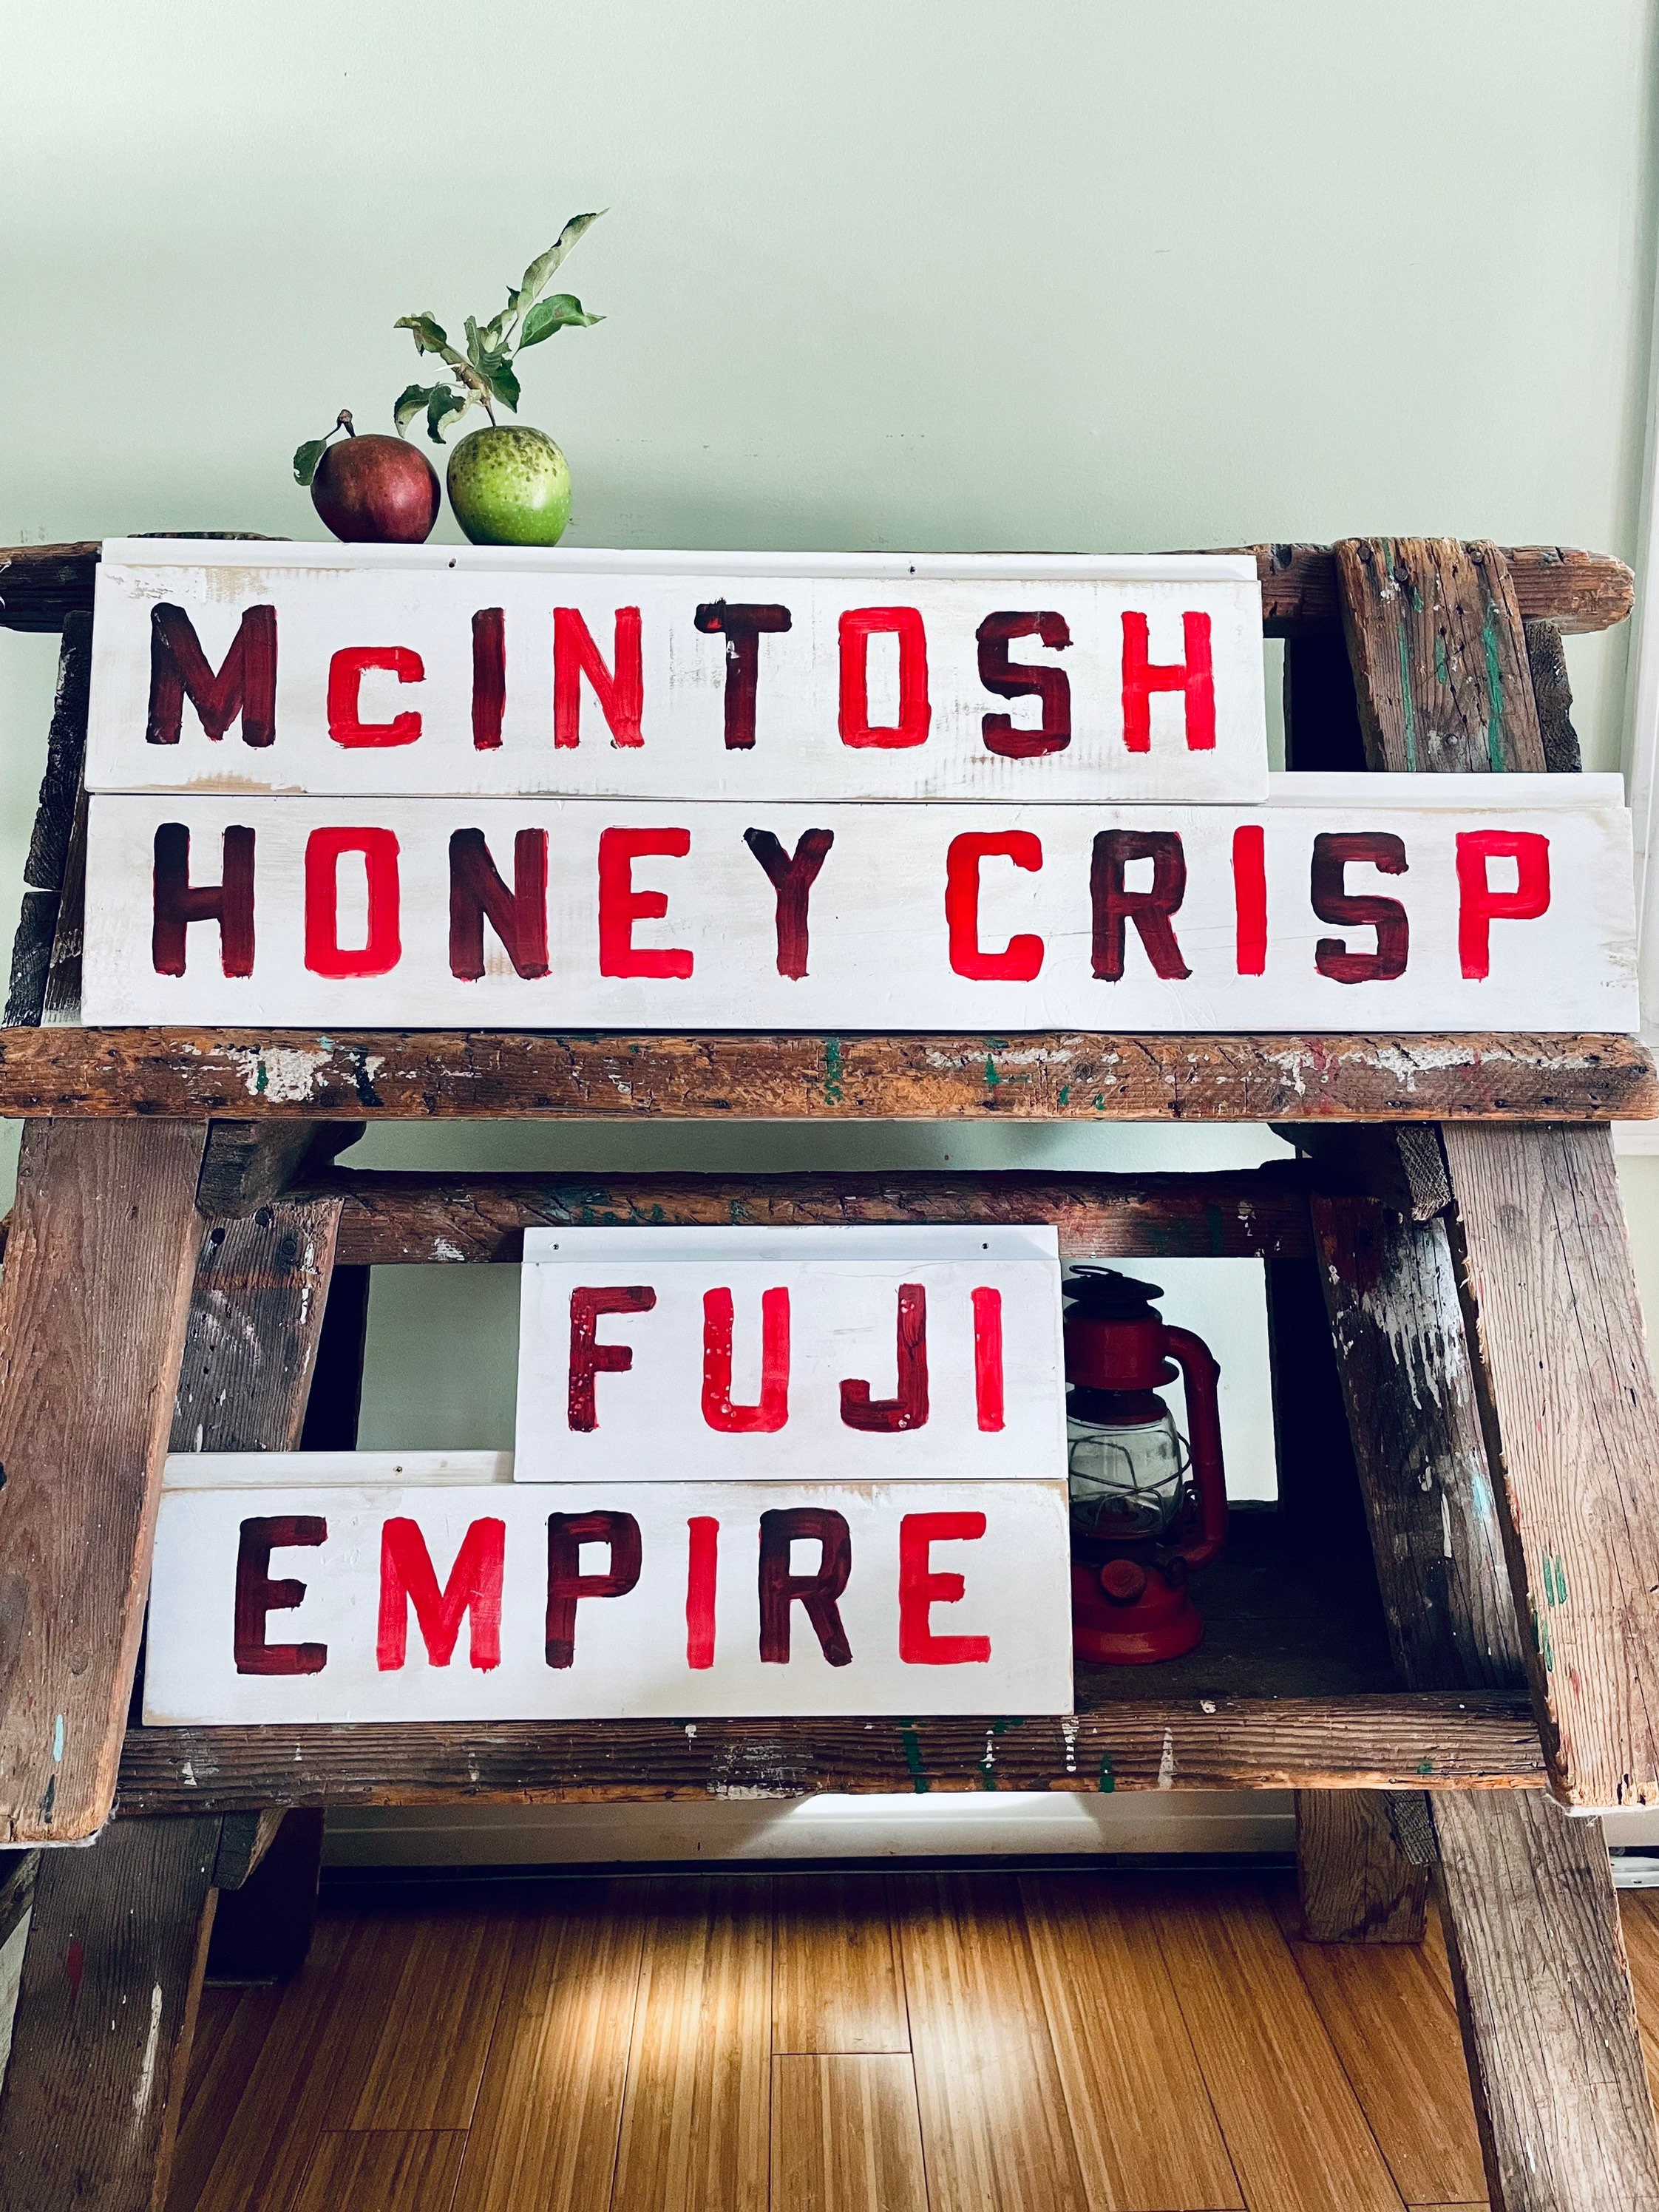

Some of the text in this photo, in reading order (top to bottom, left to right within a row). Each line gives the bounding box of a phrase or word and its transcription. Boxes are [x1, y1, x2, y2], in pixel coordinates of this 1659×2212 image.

[146, 598, 1215, 760] McINTOSH
[152, 823, 1550, 984] HONEY CRISP
[568, 1283, 1005, 1433] FUJI
[234, 1507, 991, 1675] EMPIRE
